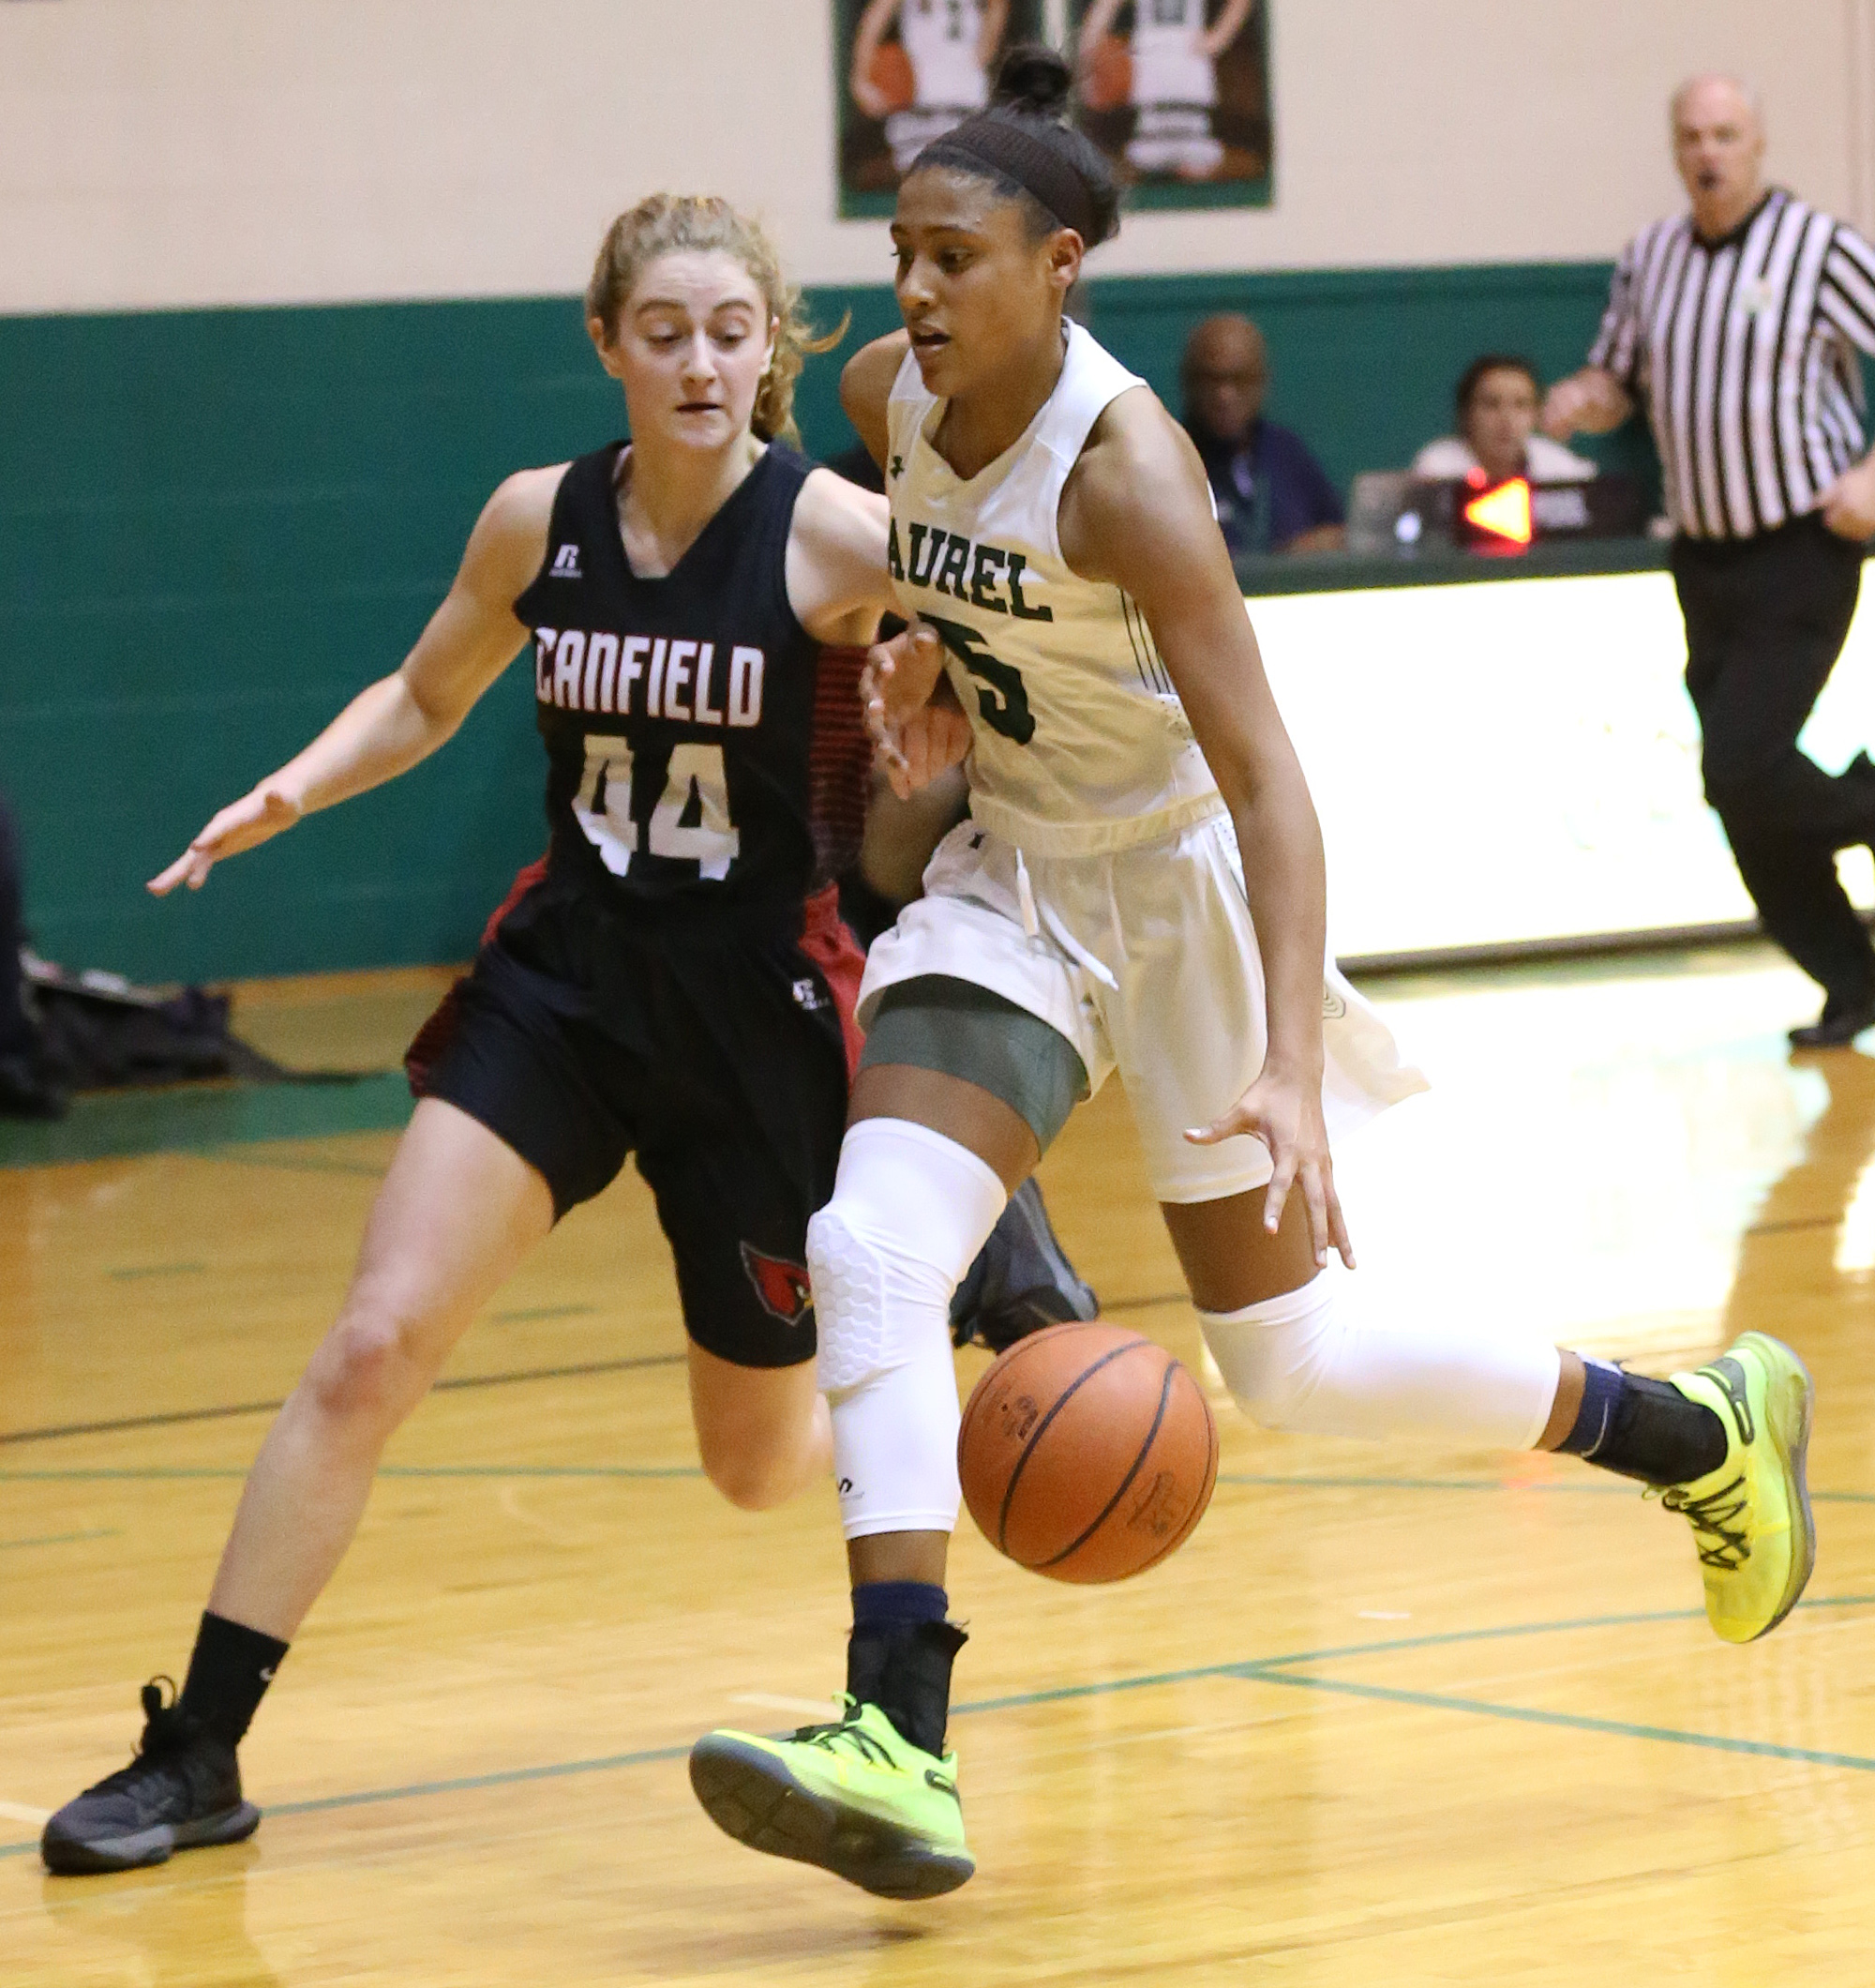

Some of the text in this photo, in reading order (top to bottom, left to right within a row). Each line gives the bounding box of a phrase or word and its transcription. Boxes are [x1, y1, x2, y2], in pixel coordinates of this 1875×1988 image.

[535, 625, 765, 728] CANFIELD
[917, 610, 1036, 745] 5
[571, 734, 740, 881] 44
